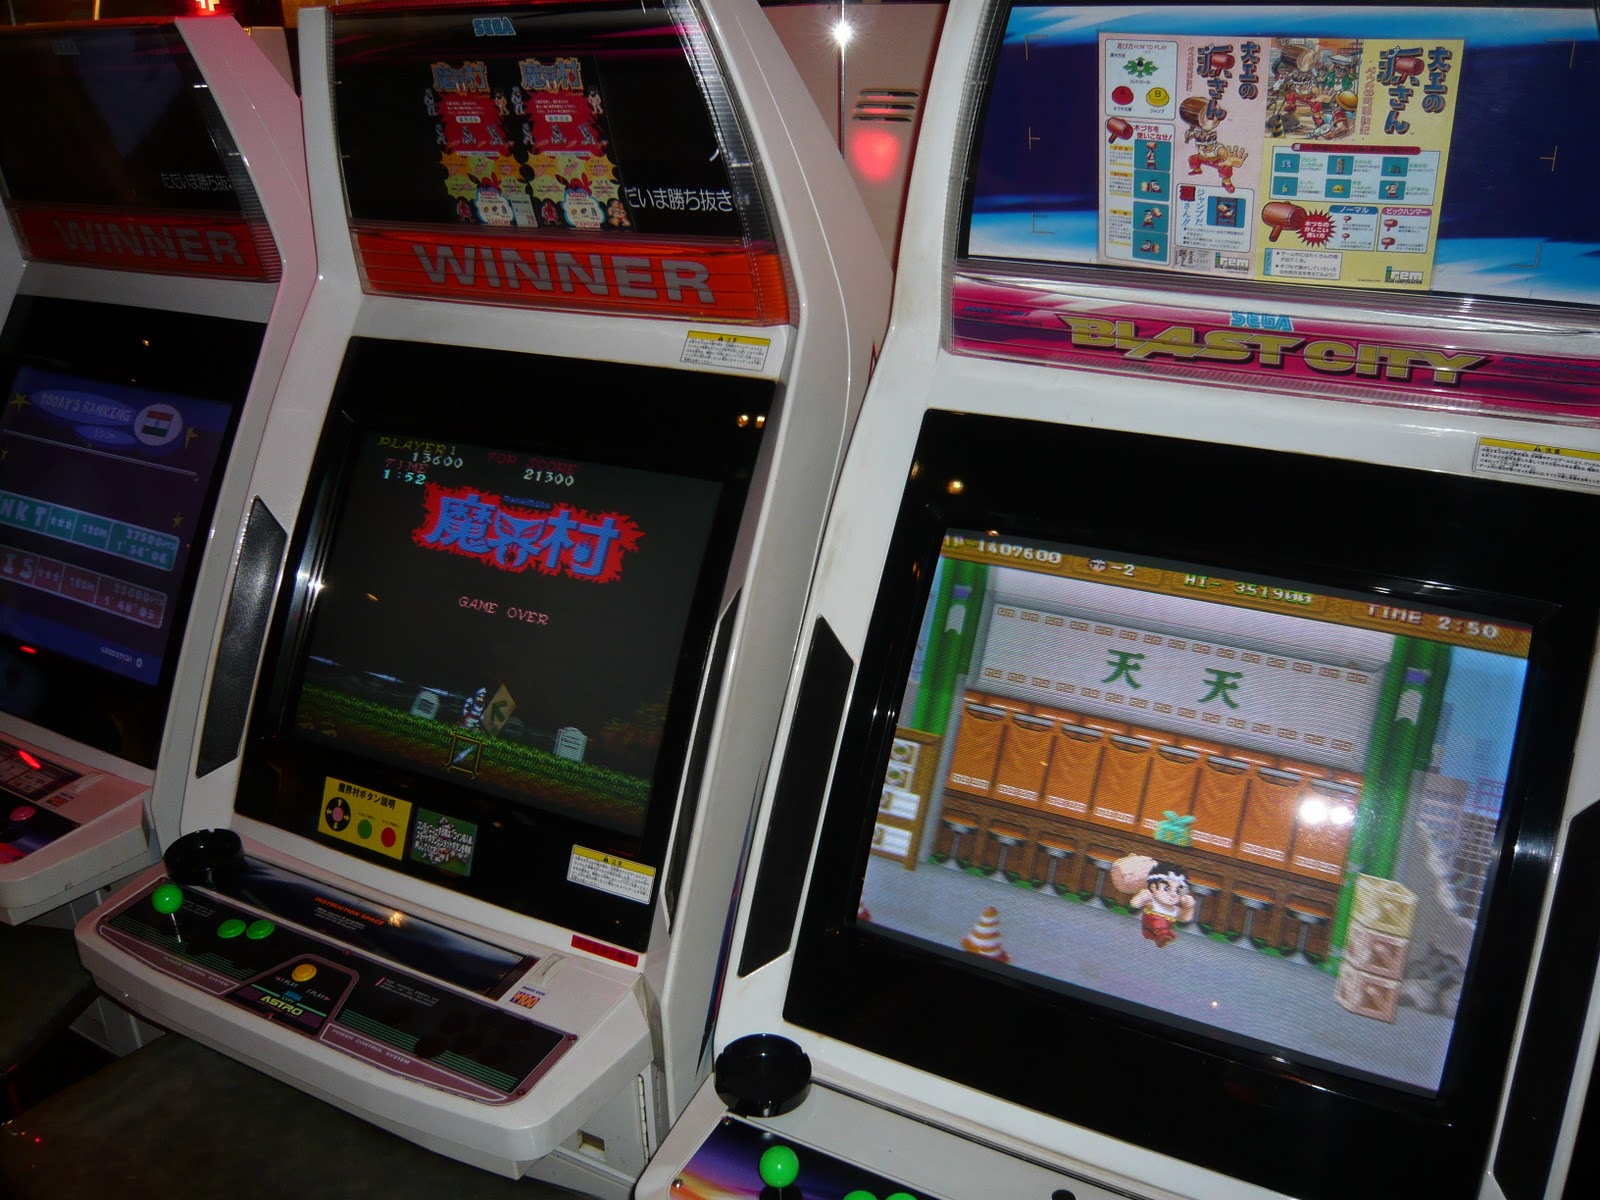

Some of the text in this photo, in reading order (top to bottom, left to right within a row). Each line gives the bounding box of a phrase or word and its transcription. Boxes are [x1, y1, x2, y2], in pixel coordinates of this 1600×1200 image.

[472, 17, 516, 36] SEGA
[1154, 90, 1161, 98] B
[53, 218, 244, 265] WINNER
[412, 243, 716, 304] WINNER
[1229, 311, 1294, 331] SEGA
[1057, 314, 1487, 386] BLAST CITY
[83, 401, 132, 422] RANKING
[377, 437, 446, 454] PLAYER
[385, 458, 429, 473] TIME
[488, 450, 577, 473] TOP SCORE
[523, 468, 575, 487] 21300
[421, 494, 622, 577] 魔界村
[458, 596, 549, 626] GAME OVER
[1368, 603, 1498, 639] TIME 2:50
[1101, 648, 1147, 690] 天
[1197, 667, 1245, 710] 天
[313, 896, 360, 918] INSTRUCTION
[360, 912, 386, 926] SPACE
[260, 995, 304, 1016] ASTRO
[355, 1038, 382, 1052] CONTROL
[385, 1051, 411, 1064] SYSTEM
